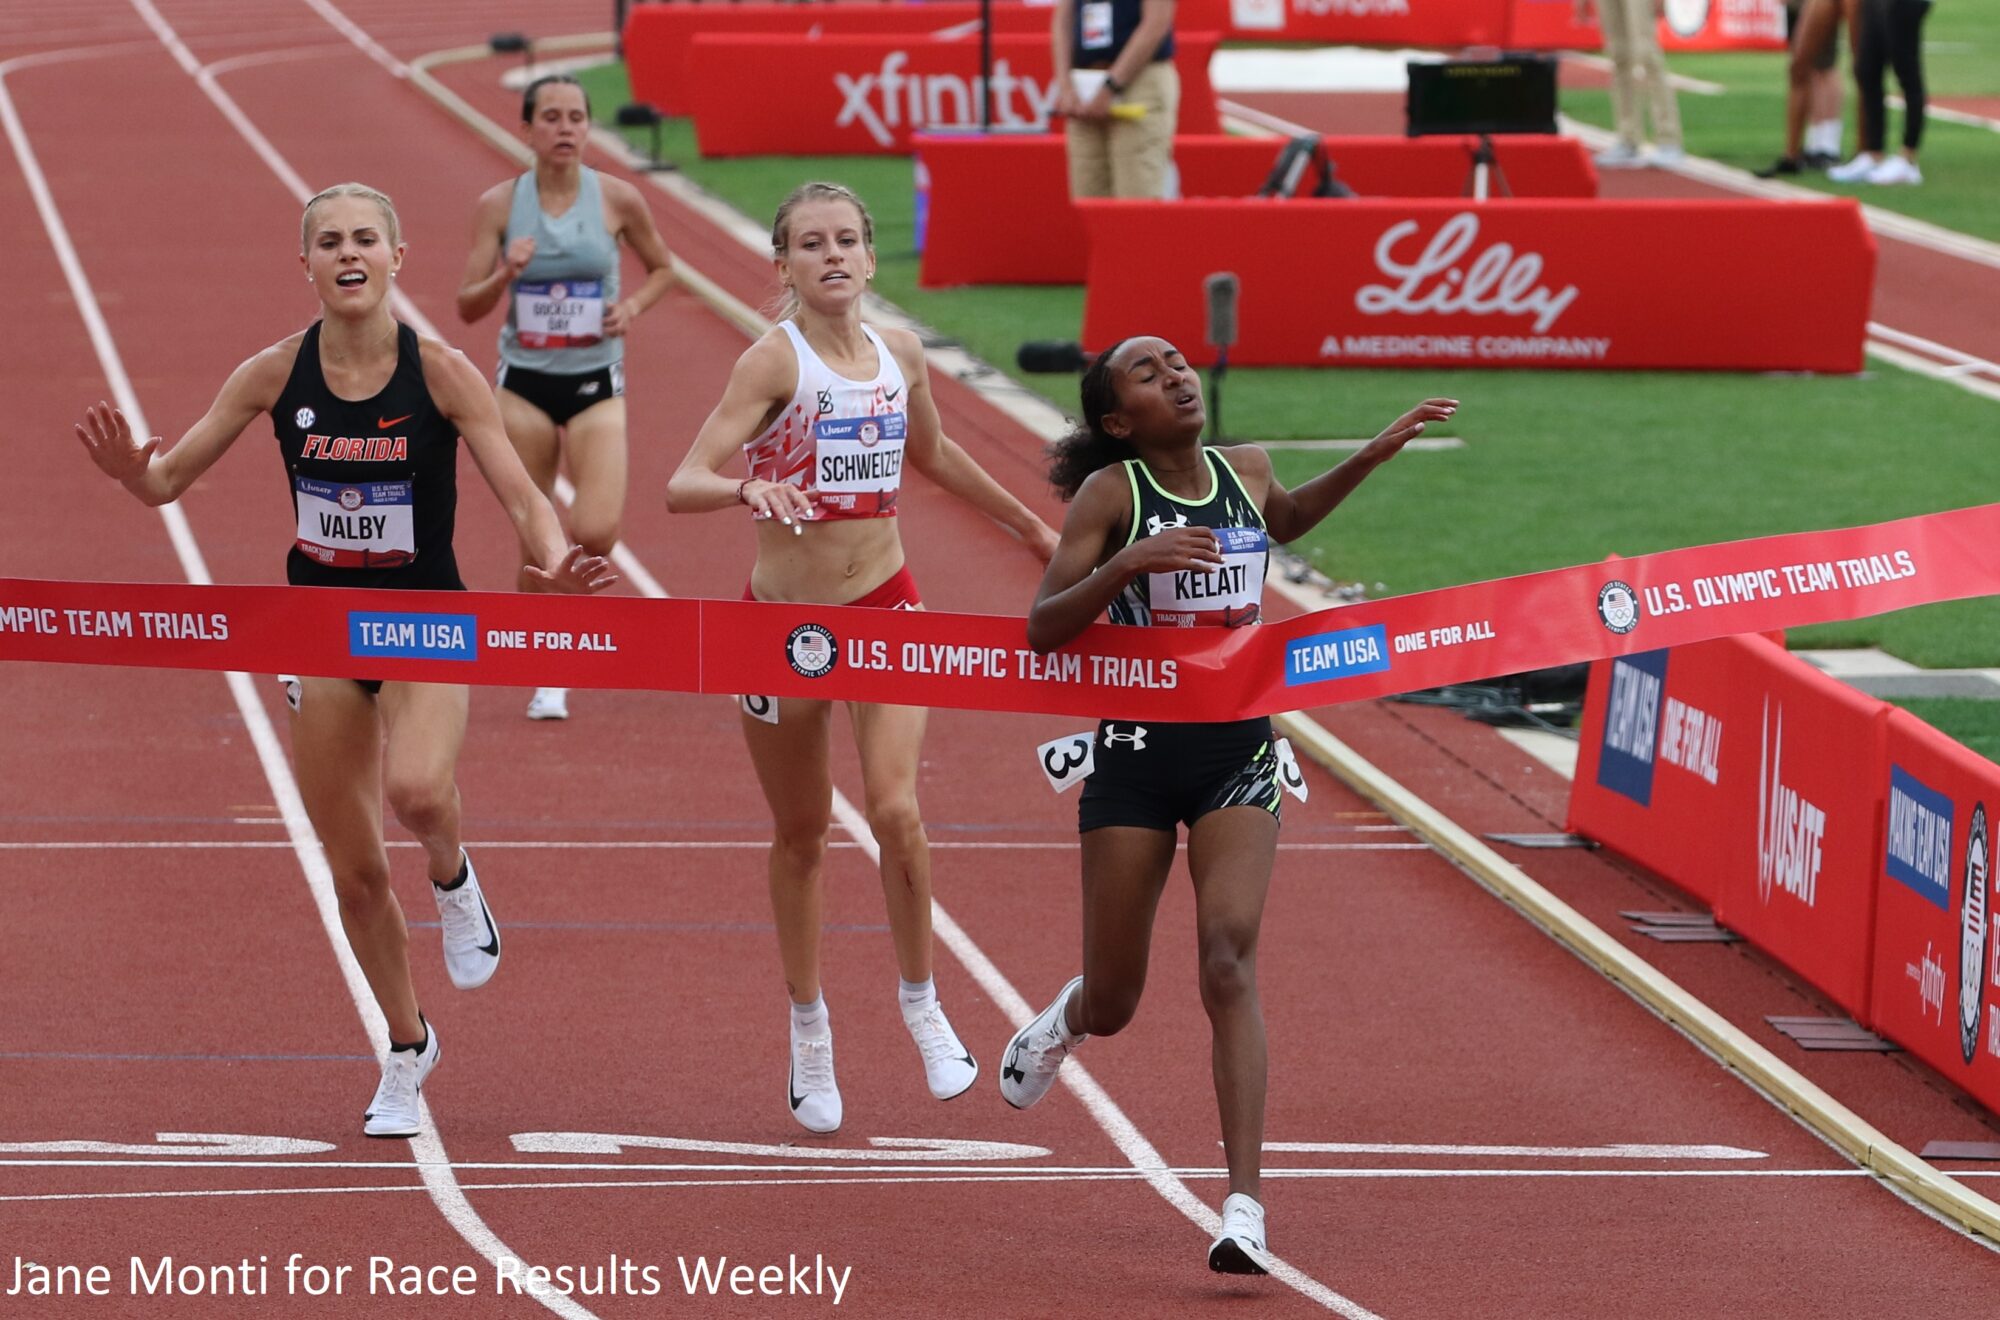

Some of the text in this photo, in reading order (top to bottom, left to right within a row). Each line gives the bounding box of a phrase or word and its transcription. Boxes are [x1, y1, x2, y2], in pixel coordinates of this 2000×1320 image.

[833, 50, 1061, 147] xfinity
[1355, 212, 1579, 333] Lilly
[1320, 336, 1610, 359] A MEDICINE COMPANY
[296, 407, 316, 429] SEC
[301, 434, 407, 461] FLORIDA
[319, 512, 386, 539] VALBY
[1175, 564, 1246, 600] KELATI
[1644, 550, 1916, 617] U.S. OLYMPIC TEAM TRIALS
[0, 606, 229, 641] MPIC TEAM TRIALS
[359, 622, 466, 650] TEAM USA
[487, 630, 617, 651] ONE FOR ALL
[1394, 621, 1496, 654] ONE FOR ALL
[847, 638, 1177, 689] U.S. OLYMPIC TEAM TRIALS
[1292, 636, 1380, 674] TEAM USA
[1045, 739, 1088, 779] 3
[1660, 696, 1722, 785] ONE FOR ALL
[1775, 784, 1826, 907] USATF
[1888, 785, 1917, 867] MAKING
[1915, 803, 1935, 879] TEAM
[1934, 815, 1951, 890] USA
